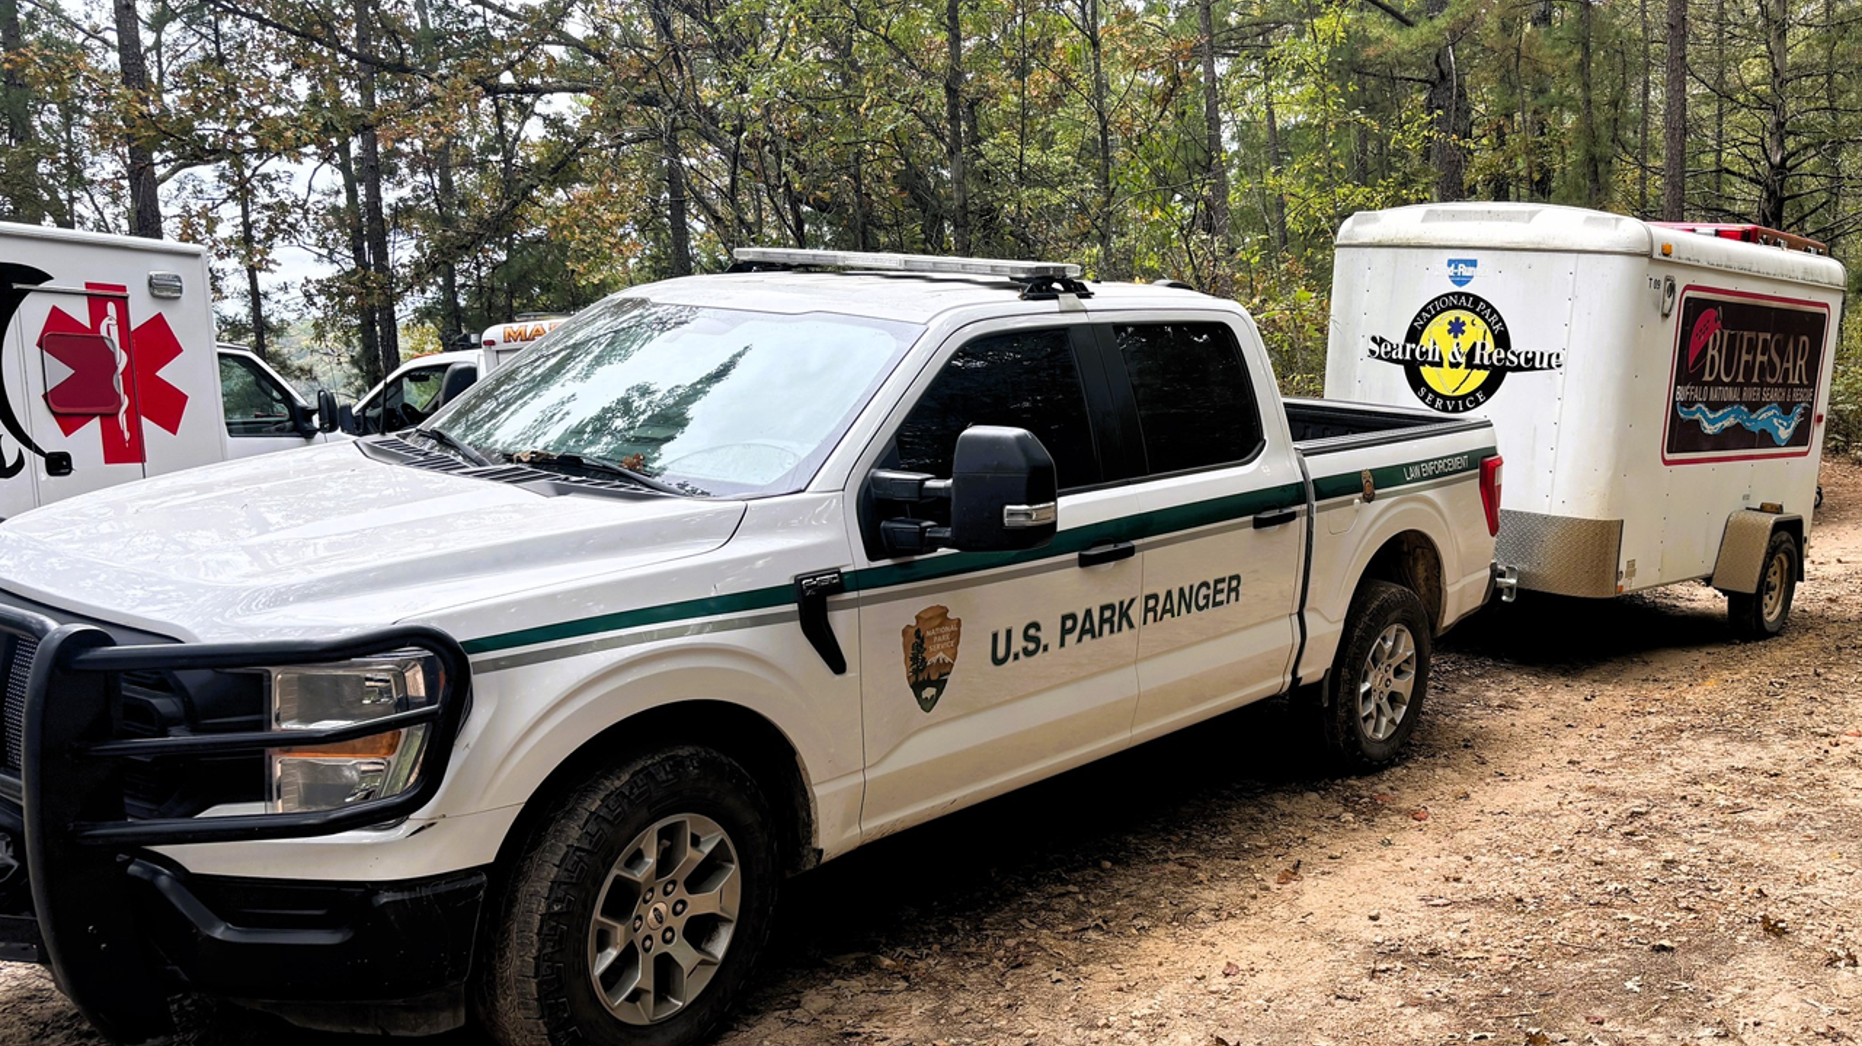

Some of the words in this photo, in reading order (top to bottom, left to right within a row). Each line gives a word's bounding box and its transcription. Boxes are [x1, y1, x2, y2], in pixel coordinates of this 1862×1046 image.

[1648, 277, 1654, 289] T
[1653, 278, 1662, 290] 09
[1413, 294, 1475, 330] NATIONAL
[1476, 301, 1505, 335] PARK
[503, 322, 559, 343] MA
[1368, 334, 1441, 363] Search
[1448, 340, 1465, 364] &
[1473, 340, 1565, 370] Rescue
[1702, 329, 1810, 385] BUFFSAR
[1417, 386, 1487, 412] SERVICE
[1675, 386, 1708, 402] BUFFALO
[1709, 386, 1741, 402] NATIONAL
[1742, 387, 1761, 402] RIVER
[1761, 387, 1786, 402] SEARCH
[1792, 388, 1814, 402] RESCUE
[1403, 465, 1421, 480] LAW
[1420, 455, 1469, 477] ENFORCEMENT
[926, 624, 958, 637] NATIONAL
[990, 621, 1049, 666] U.S.
[1059, 597, 1138, 649] PARK
[1142, 573, 1242, 626] RANGER
